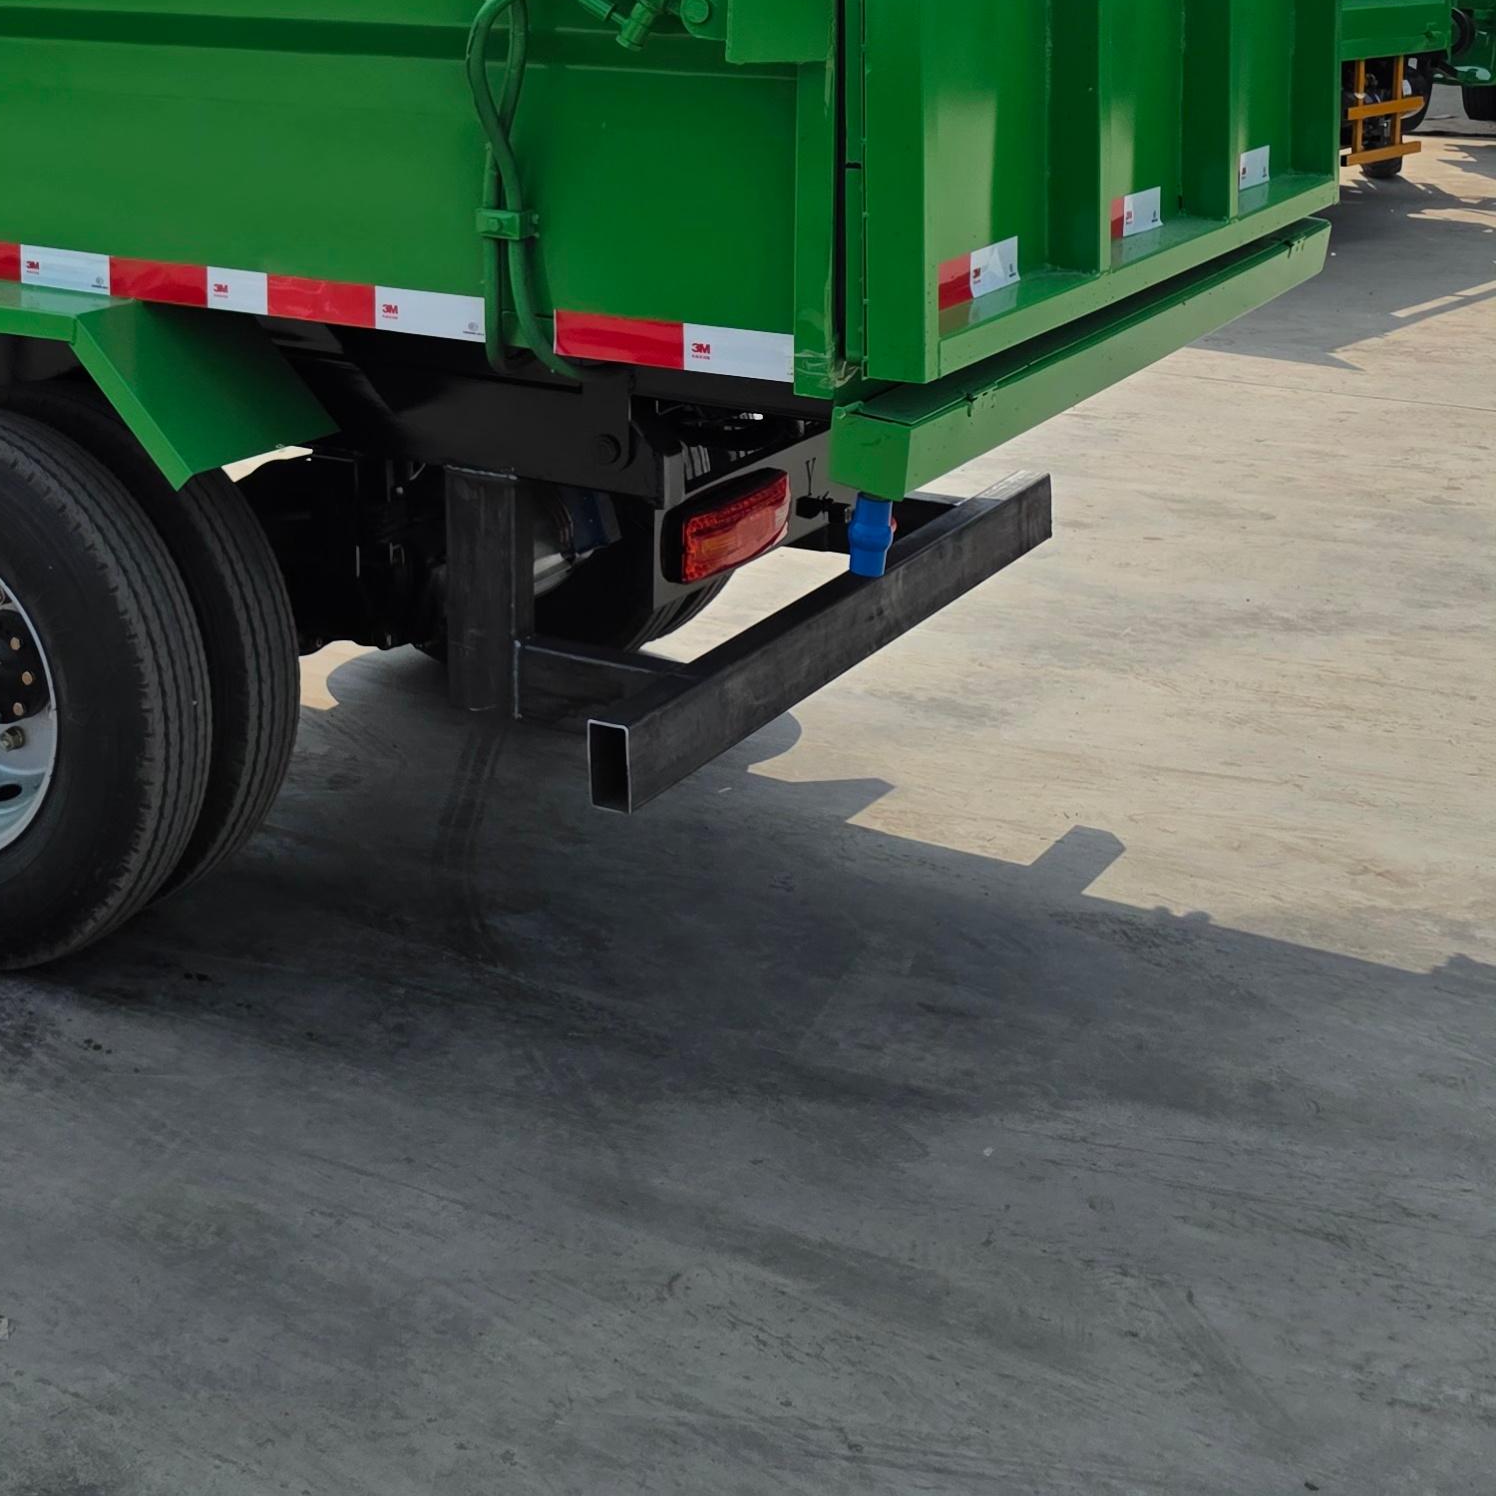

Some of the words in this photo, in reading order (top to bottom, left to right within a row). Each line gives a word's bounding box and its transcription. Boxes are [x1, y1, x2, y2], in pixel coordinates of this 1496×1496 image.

[26, 260, 39, 269] 3M
[213, 283, 228, 293] 3M
[382, 304, 399, 314] 3M
[691, 343, 711, 354] 3M
